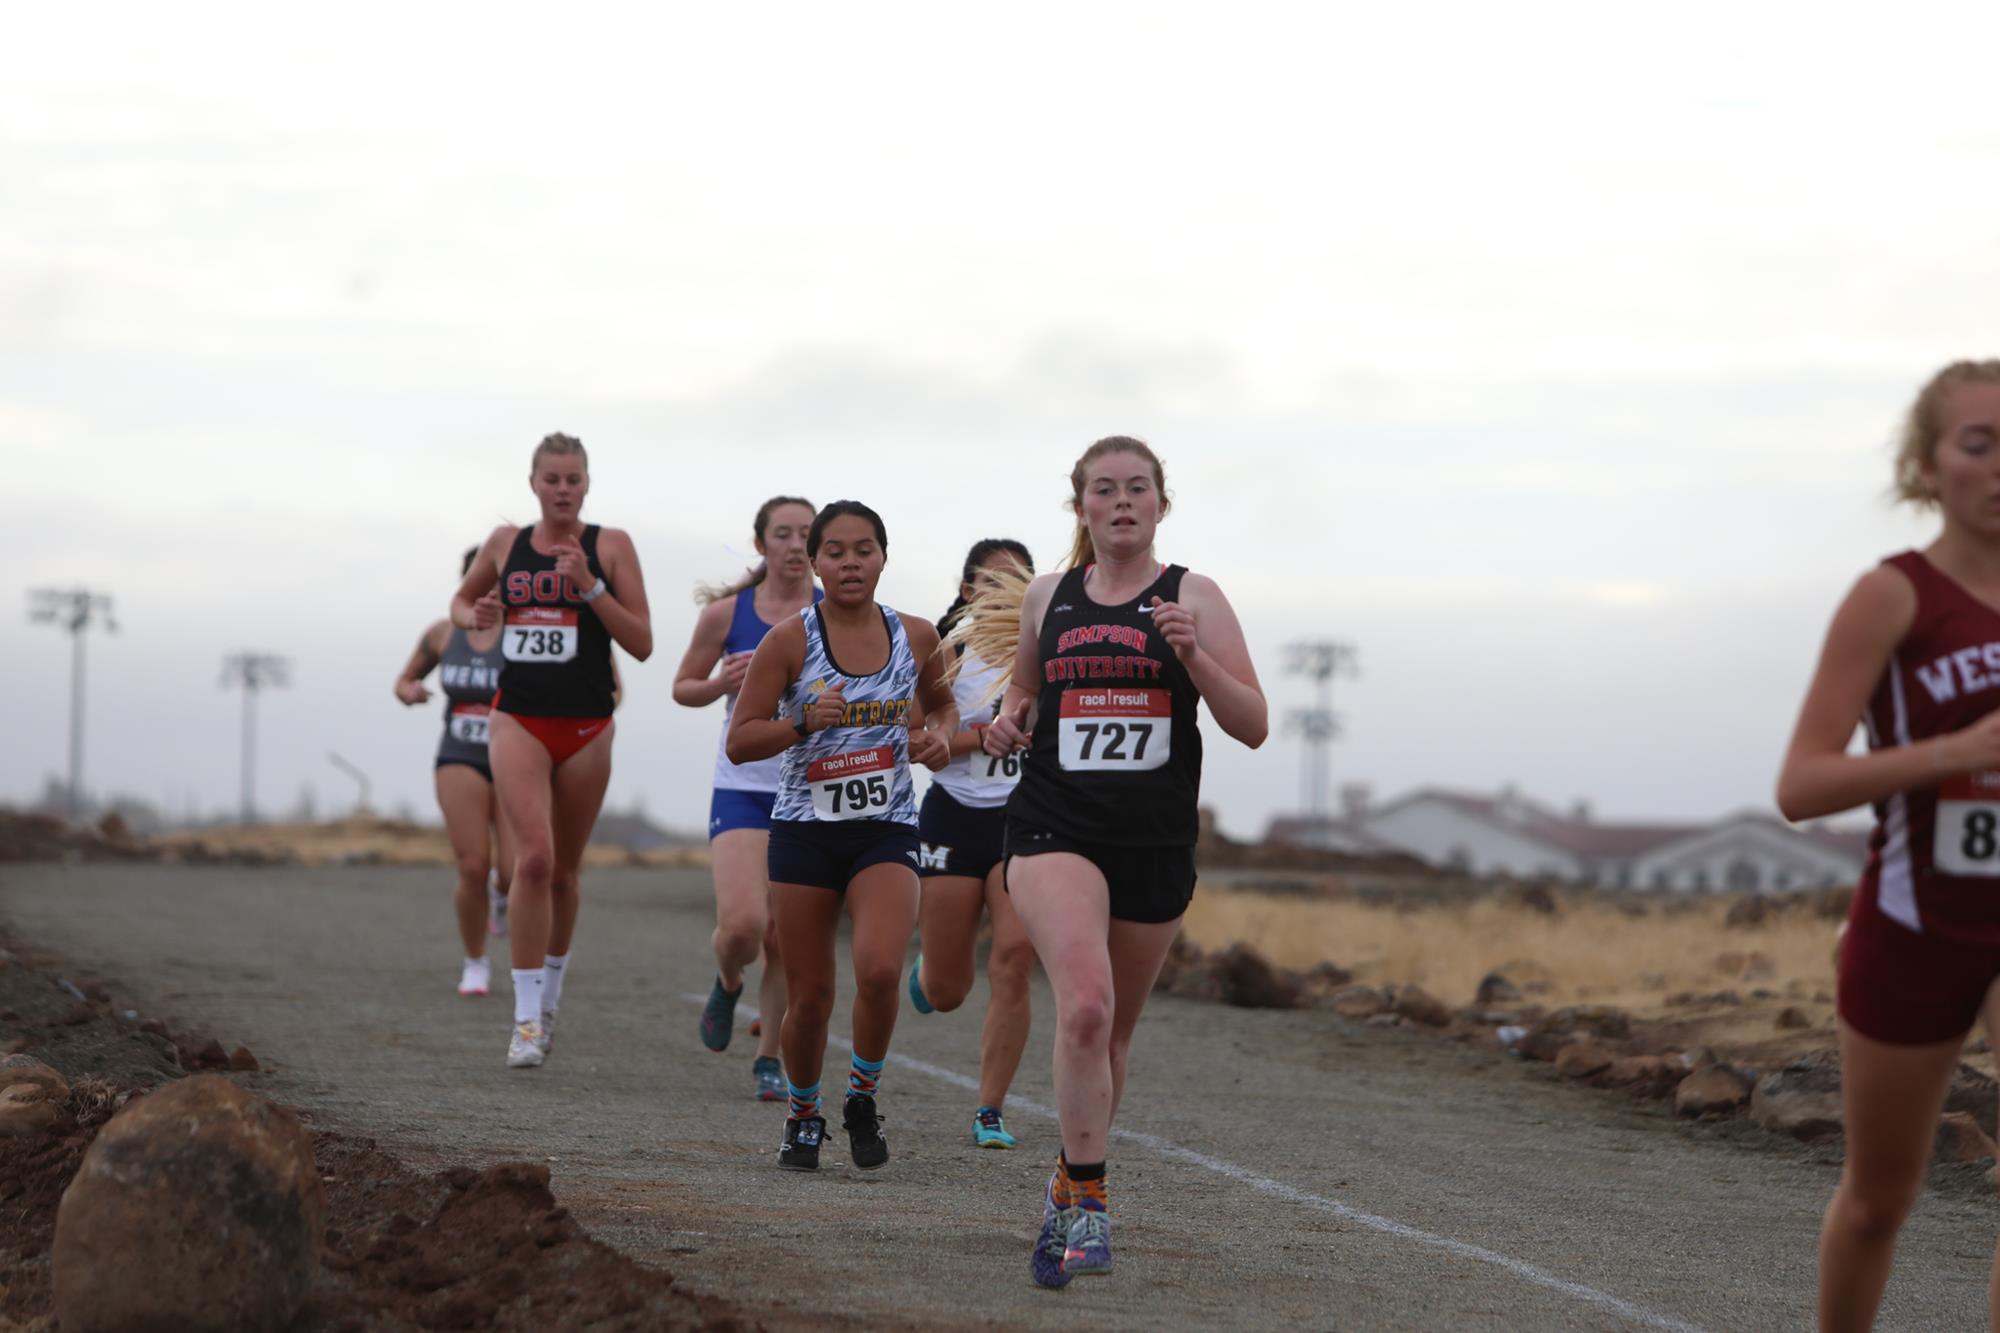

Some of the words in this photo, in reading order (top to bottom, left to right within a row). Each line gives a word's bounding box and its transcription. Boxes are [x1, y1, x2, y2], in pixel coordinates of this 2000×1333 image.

[515, 629, 564, 655] 738
[1057, 625, 1148, 653] SIMPSON
[1044, 656, 1163, 682] UNIVERSITY
[1075, 723, 1153, 760] 727
[823, 774, 888, 814] 795
